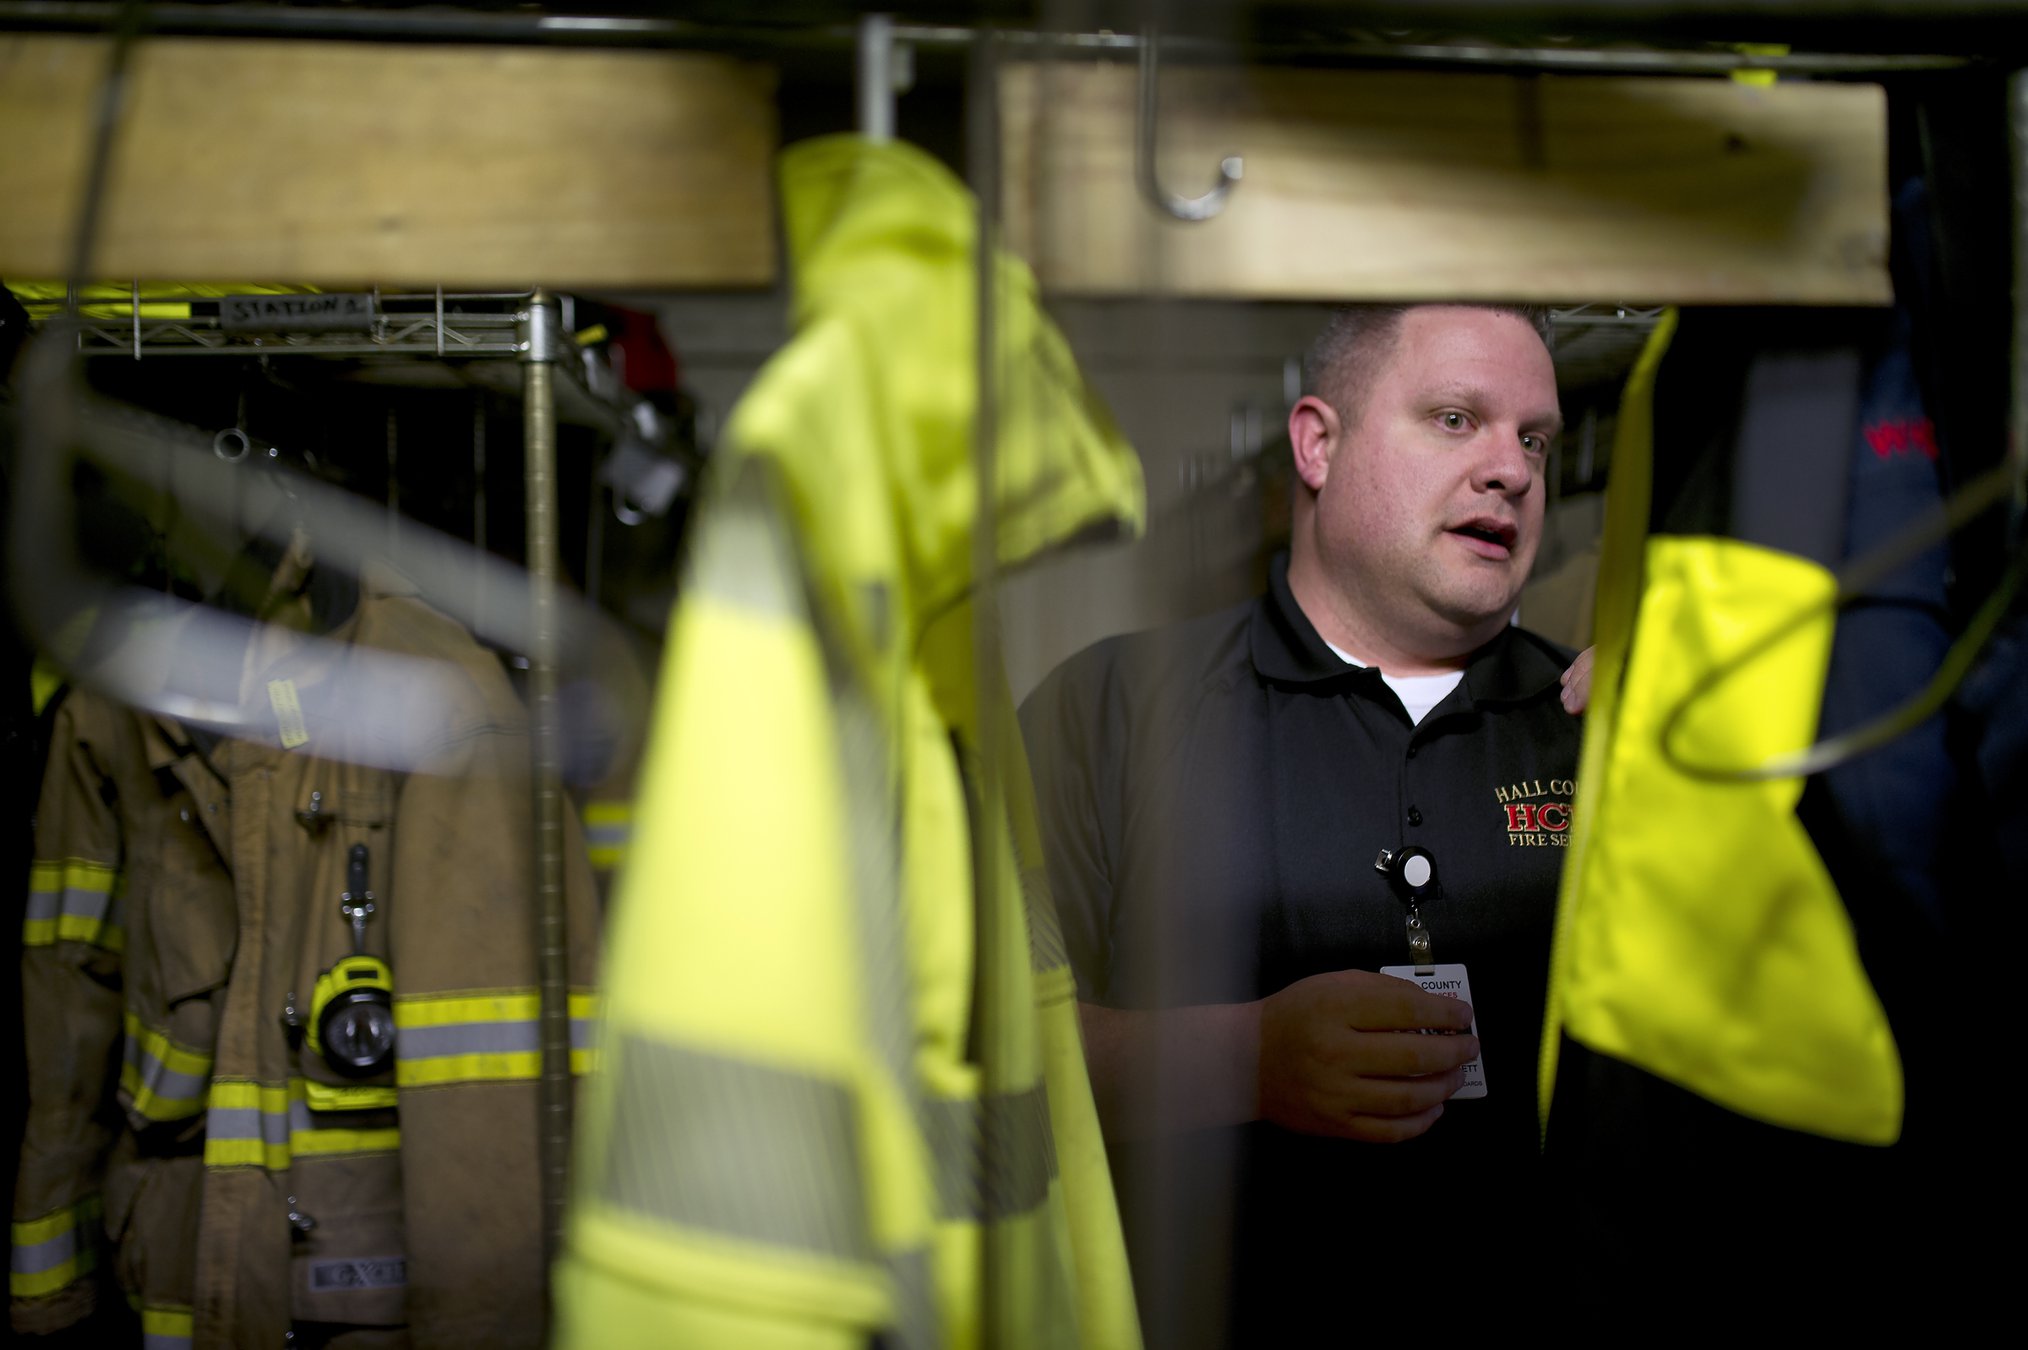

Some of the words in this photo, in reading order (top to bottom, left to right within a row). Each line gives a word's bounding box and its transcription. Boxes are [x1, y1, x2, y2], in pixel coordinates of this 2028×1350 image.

[231, 296, 338, 321] STATION
[1494, 780, 1548, 803] HALL
[1550, 780, 1578, 796] CO
[1504, 803, 1575, 832] HC
[1509, 833, 1548, 847] FIRE
[1550, 833, 1573, 847] SE
[1421, 981, 1462, 990] COUNTY
[1460, 1064, 1478, 1073] ETT
